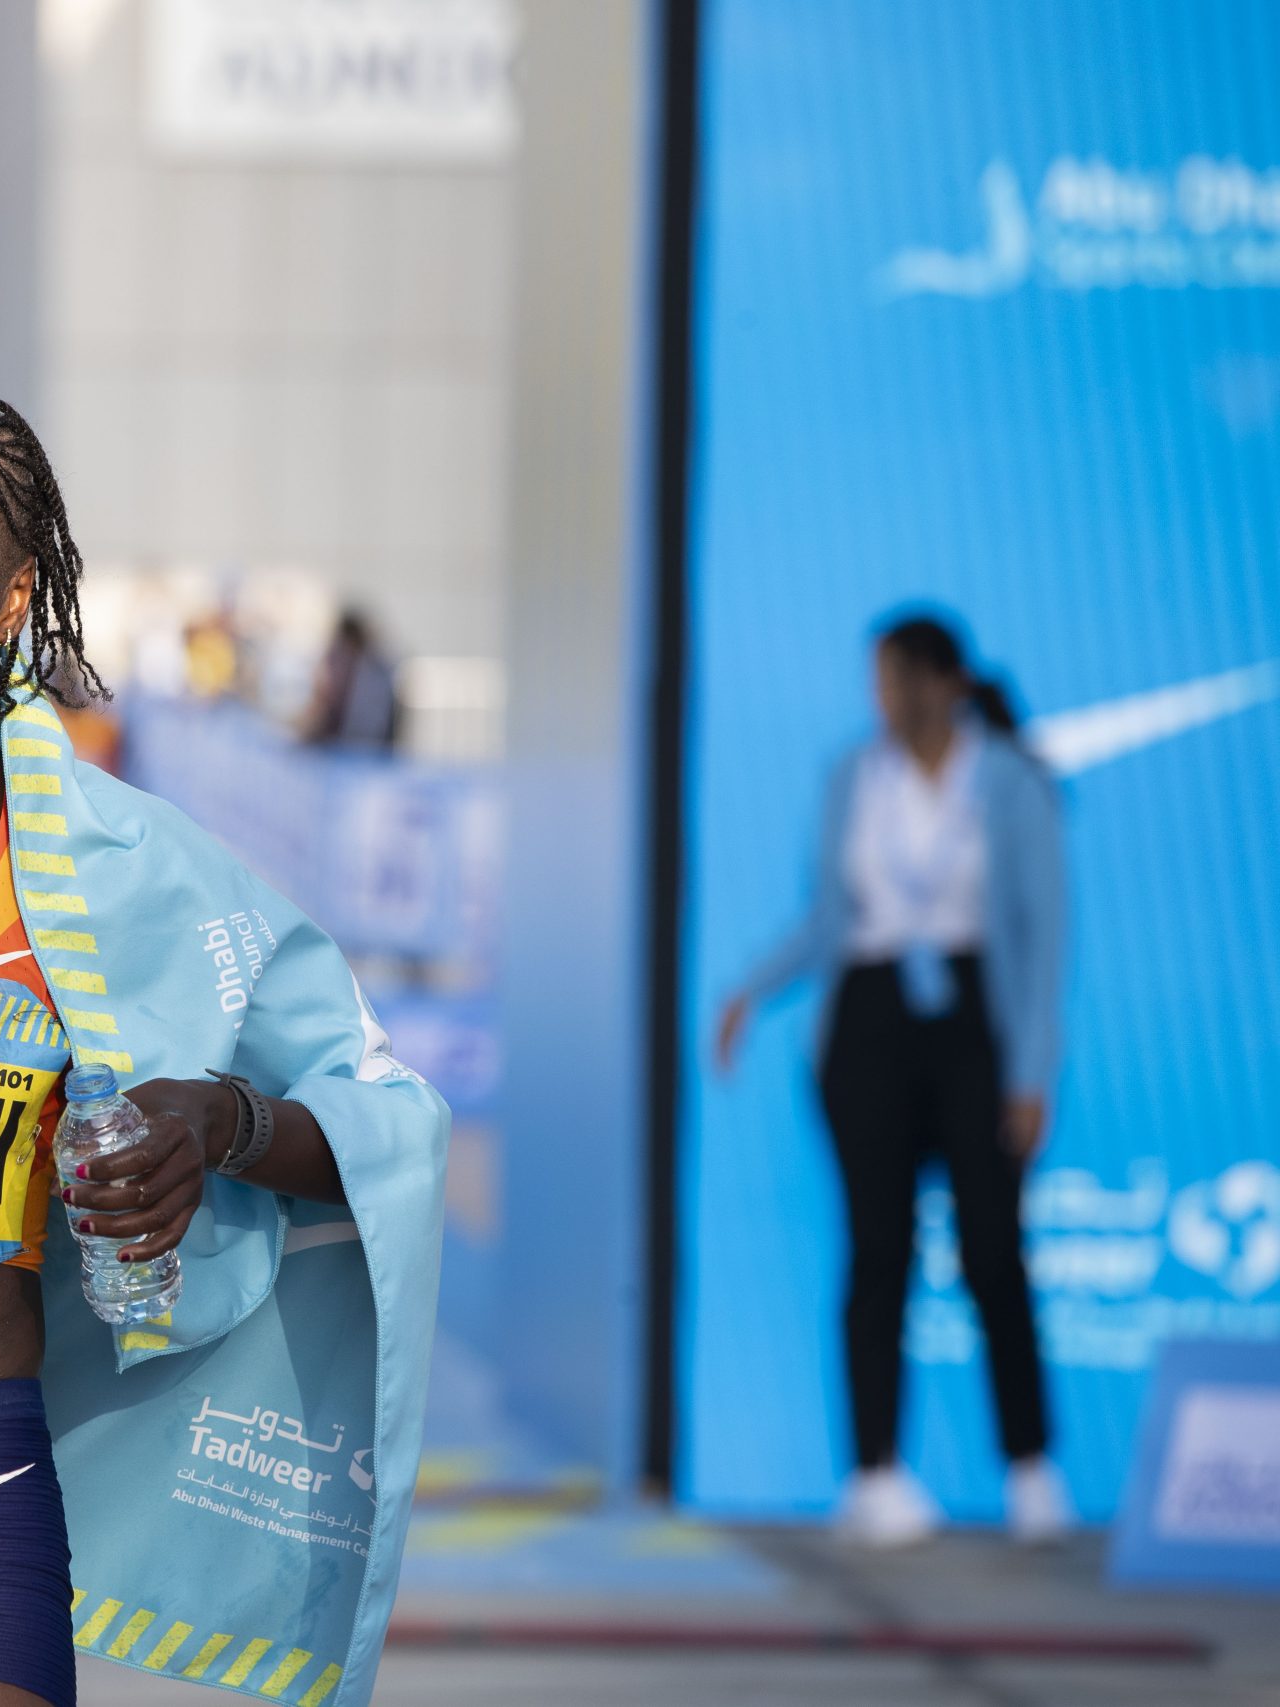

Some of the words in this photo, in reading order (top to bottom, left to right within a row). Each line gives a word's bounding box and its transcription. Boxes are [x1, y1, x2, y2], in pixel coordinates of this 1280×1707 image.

[197, 918, 248, 1014] Dhabi
[191, 1396, 345, 1453] تدوير
[189, 1425, 332, 1494] Tadweer
[171, 1487, 197, 1505] Abu
[197, 1495, 231, 1517] Dhabi
[230, 1507, 266, 1529] Waste
[267, 1519, 351, 1550] Management
